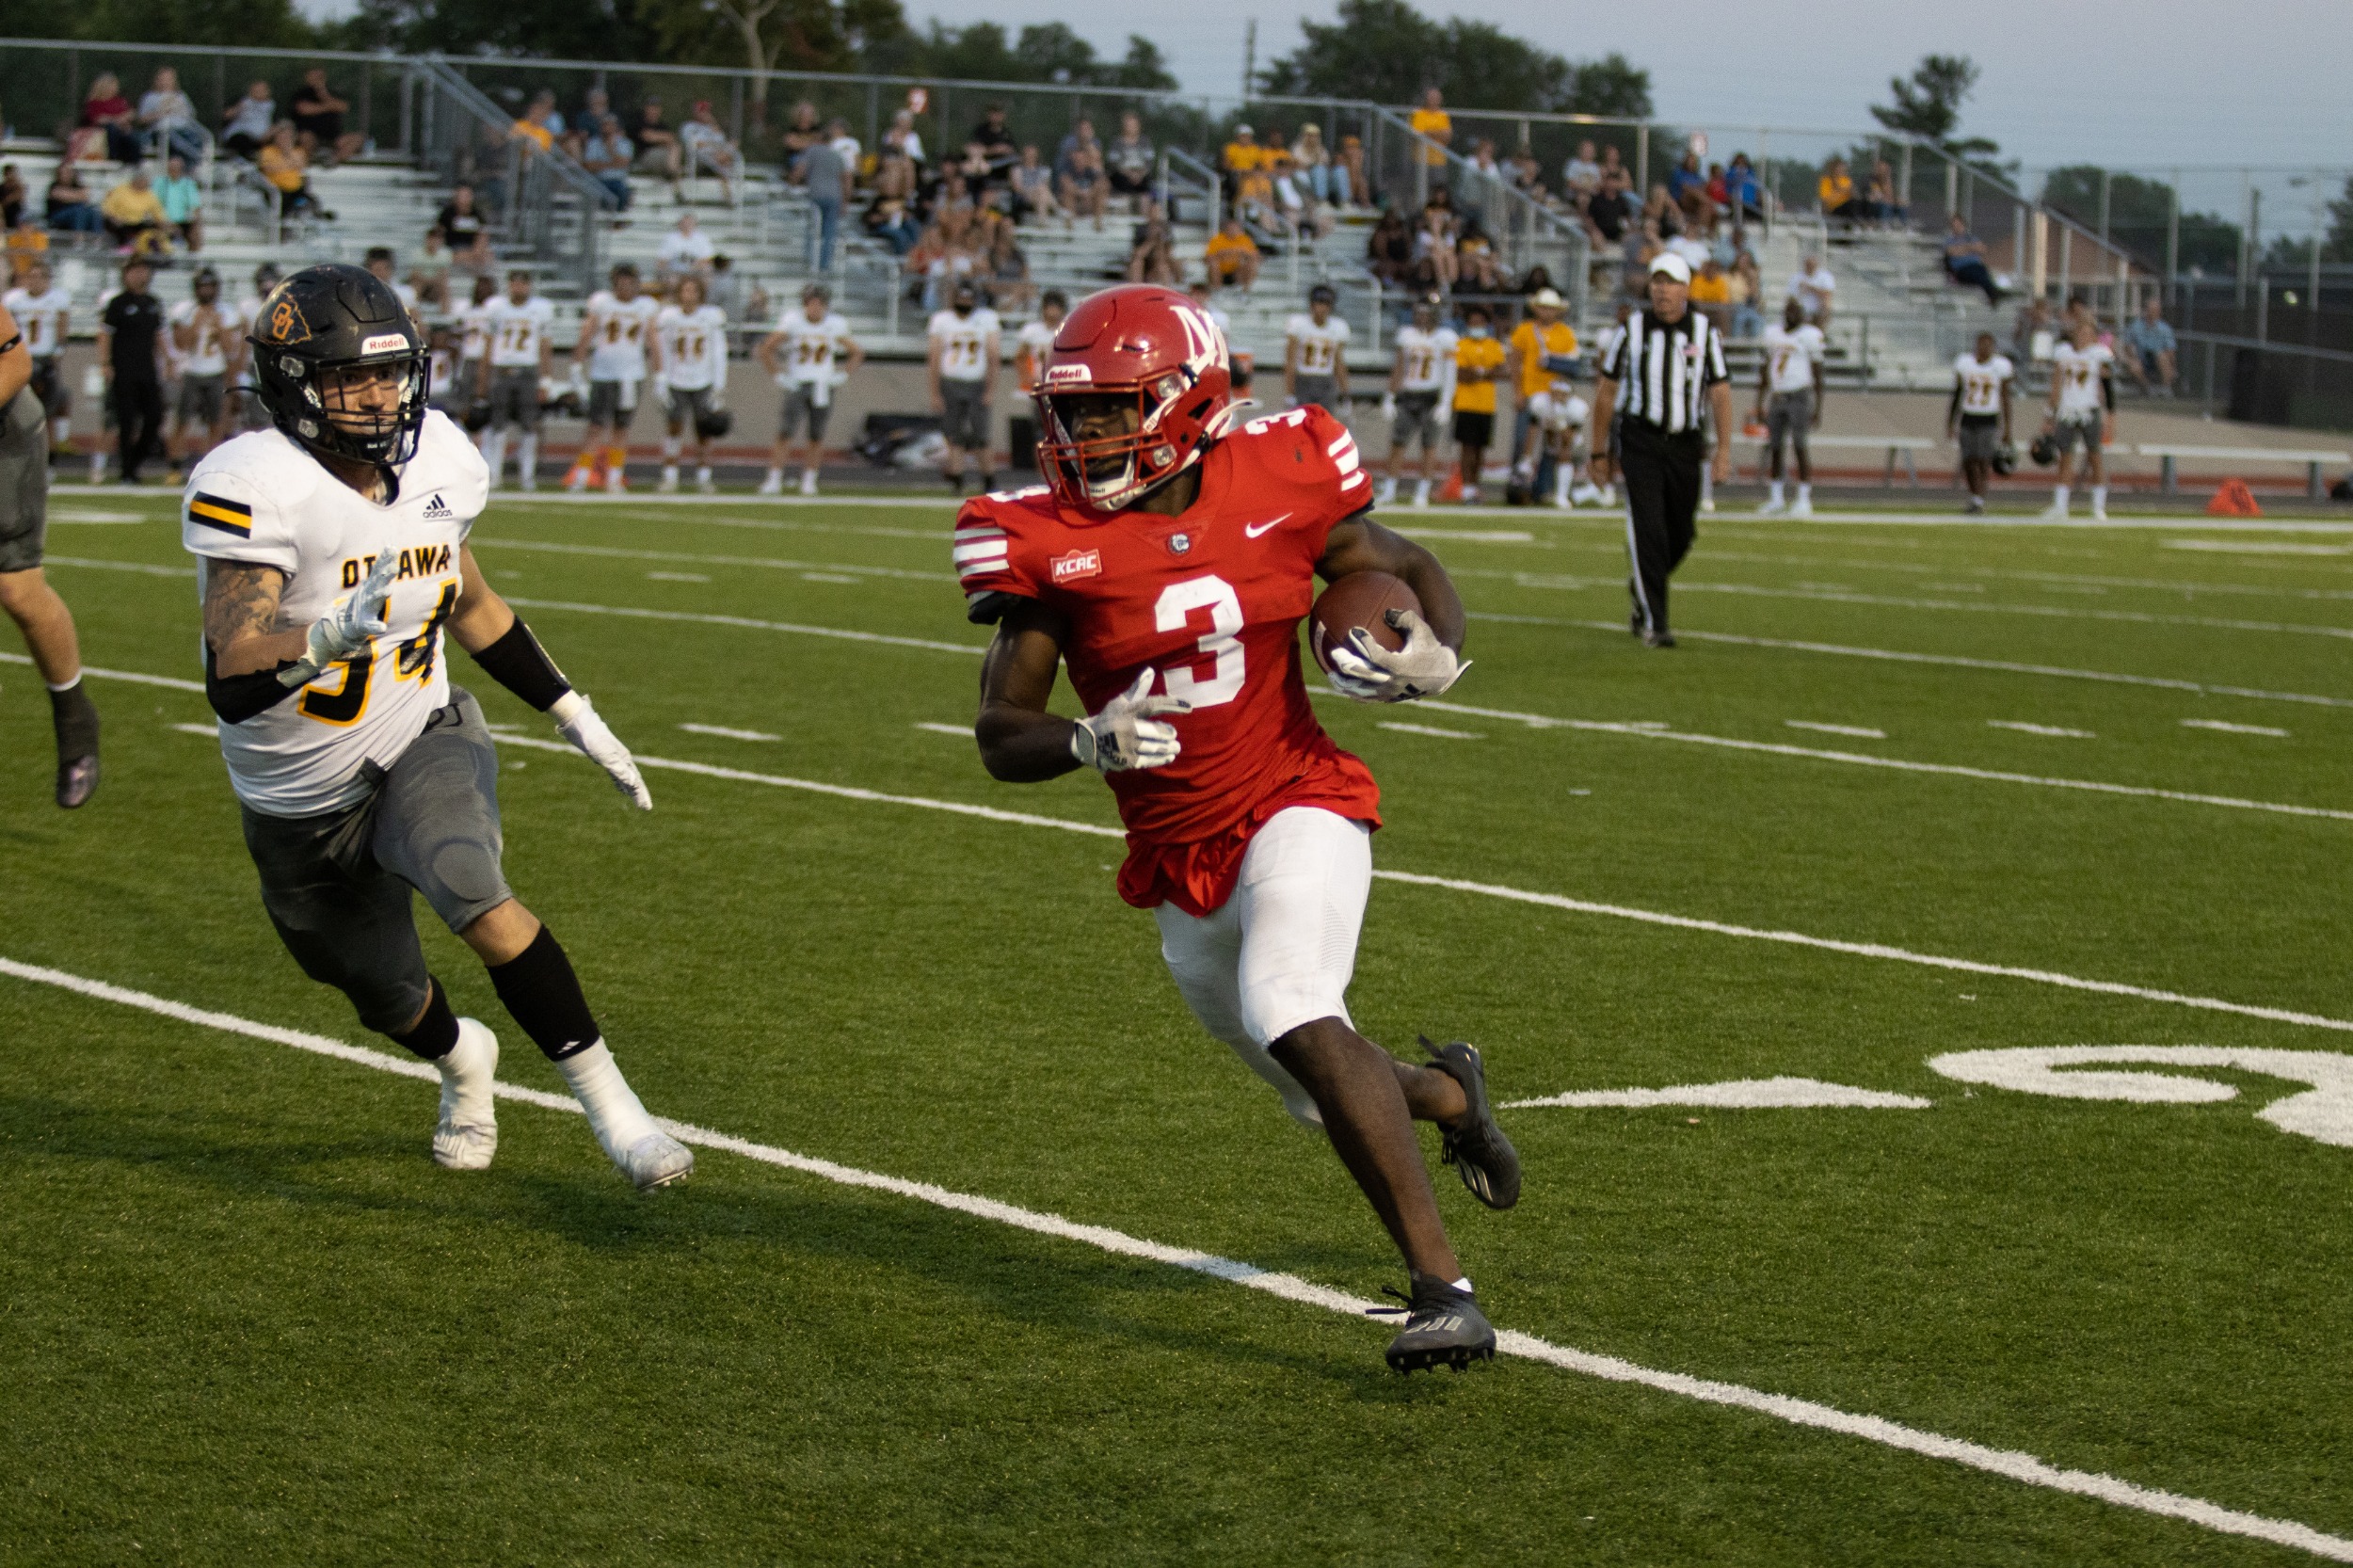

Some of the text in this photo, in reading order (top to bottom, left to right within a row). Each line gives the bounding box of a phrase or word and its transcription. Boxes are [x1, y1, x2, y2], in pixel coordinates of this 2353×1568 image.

[370, 338, 405, 349] Riddell
[423, 509, 453, 519] adidas
[340, 542, 454, 590] OTAWA
[1055, 554, 1097, 576] KCAC
[1155, 574, 1246, 708] 3
